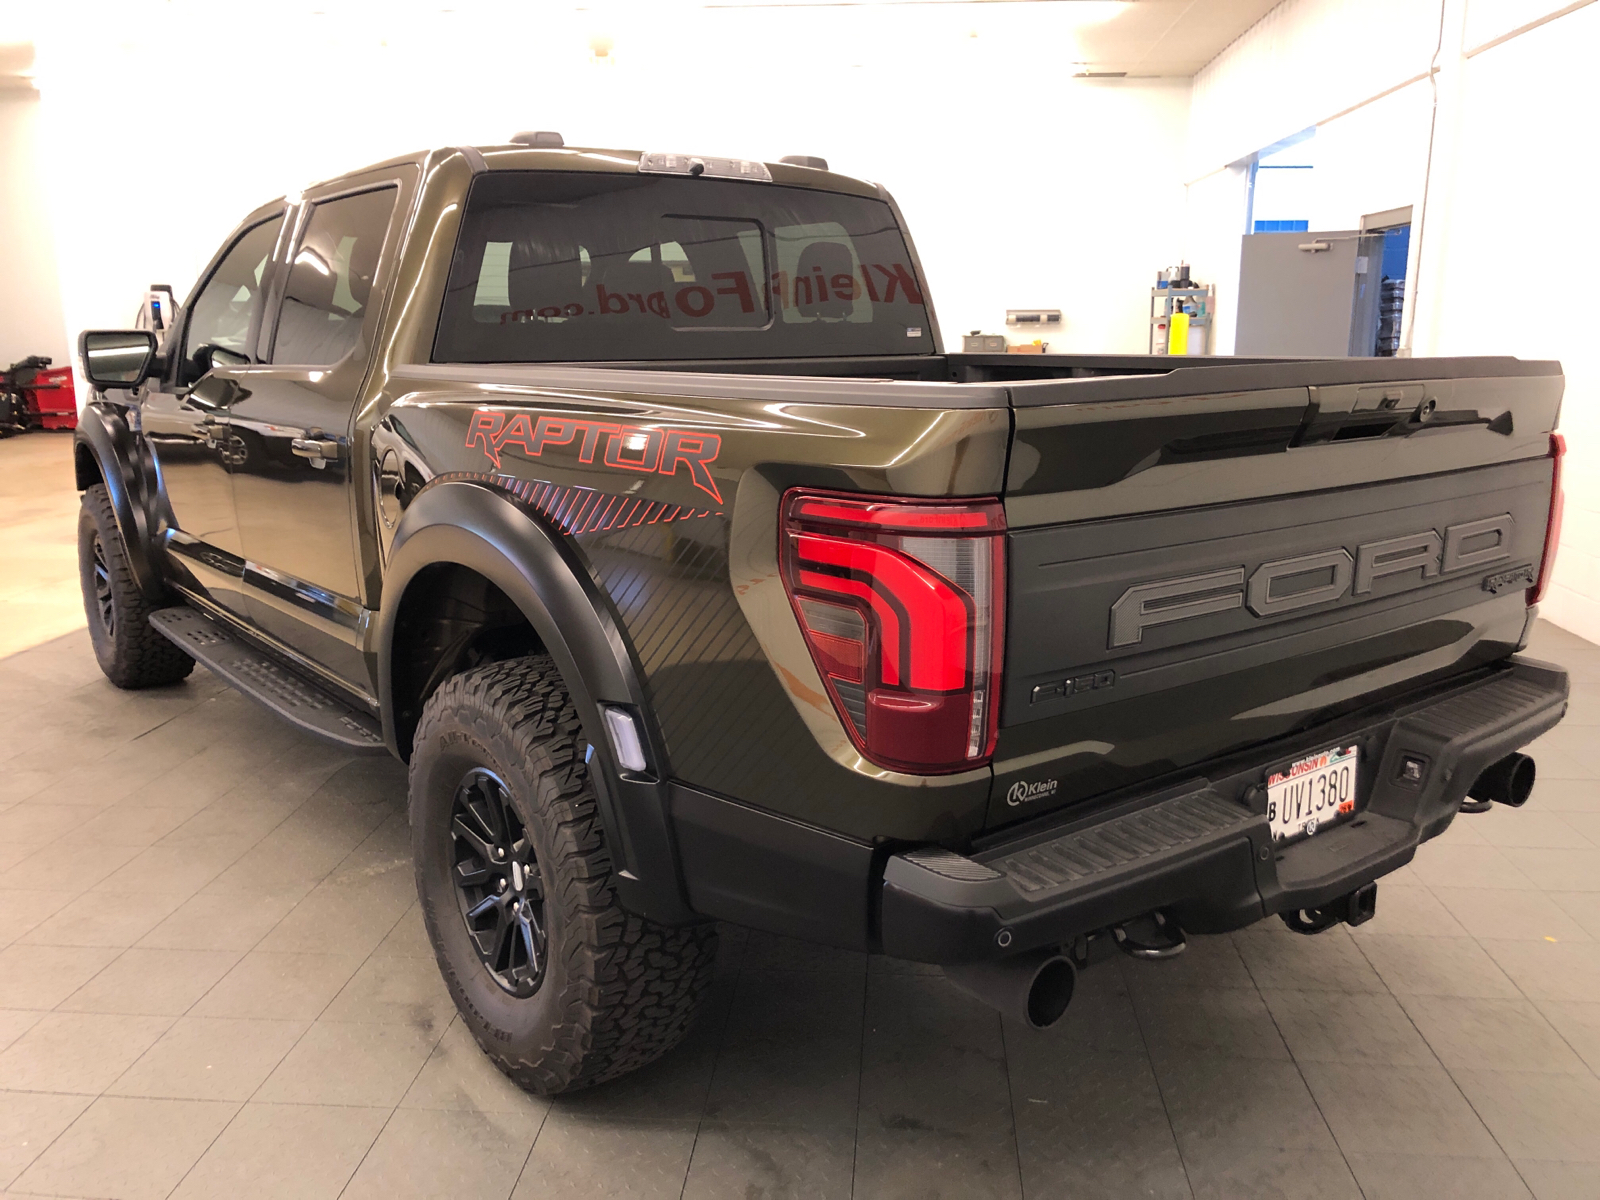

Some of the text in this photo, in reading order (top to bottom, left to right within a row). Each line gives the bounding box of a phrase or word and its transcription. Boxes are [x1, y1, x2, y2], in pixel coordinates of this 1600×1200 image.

[466, 410, 723, 505] RAPTOR
[1107, 512, 1515, 650] FORD
[1028, 778, 1058, 795] Klein
[1268, 801, 1277, 822] B
[1282, 765, 1349, 825] UV1380
